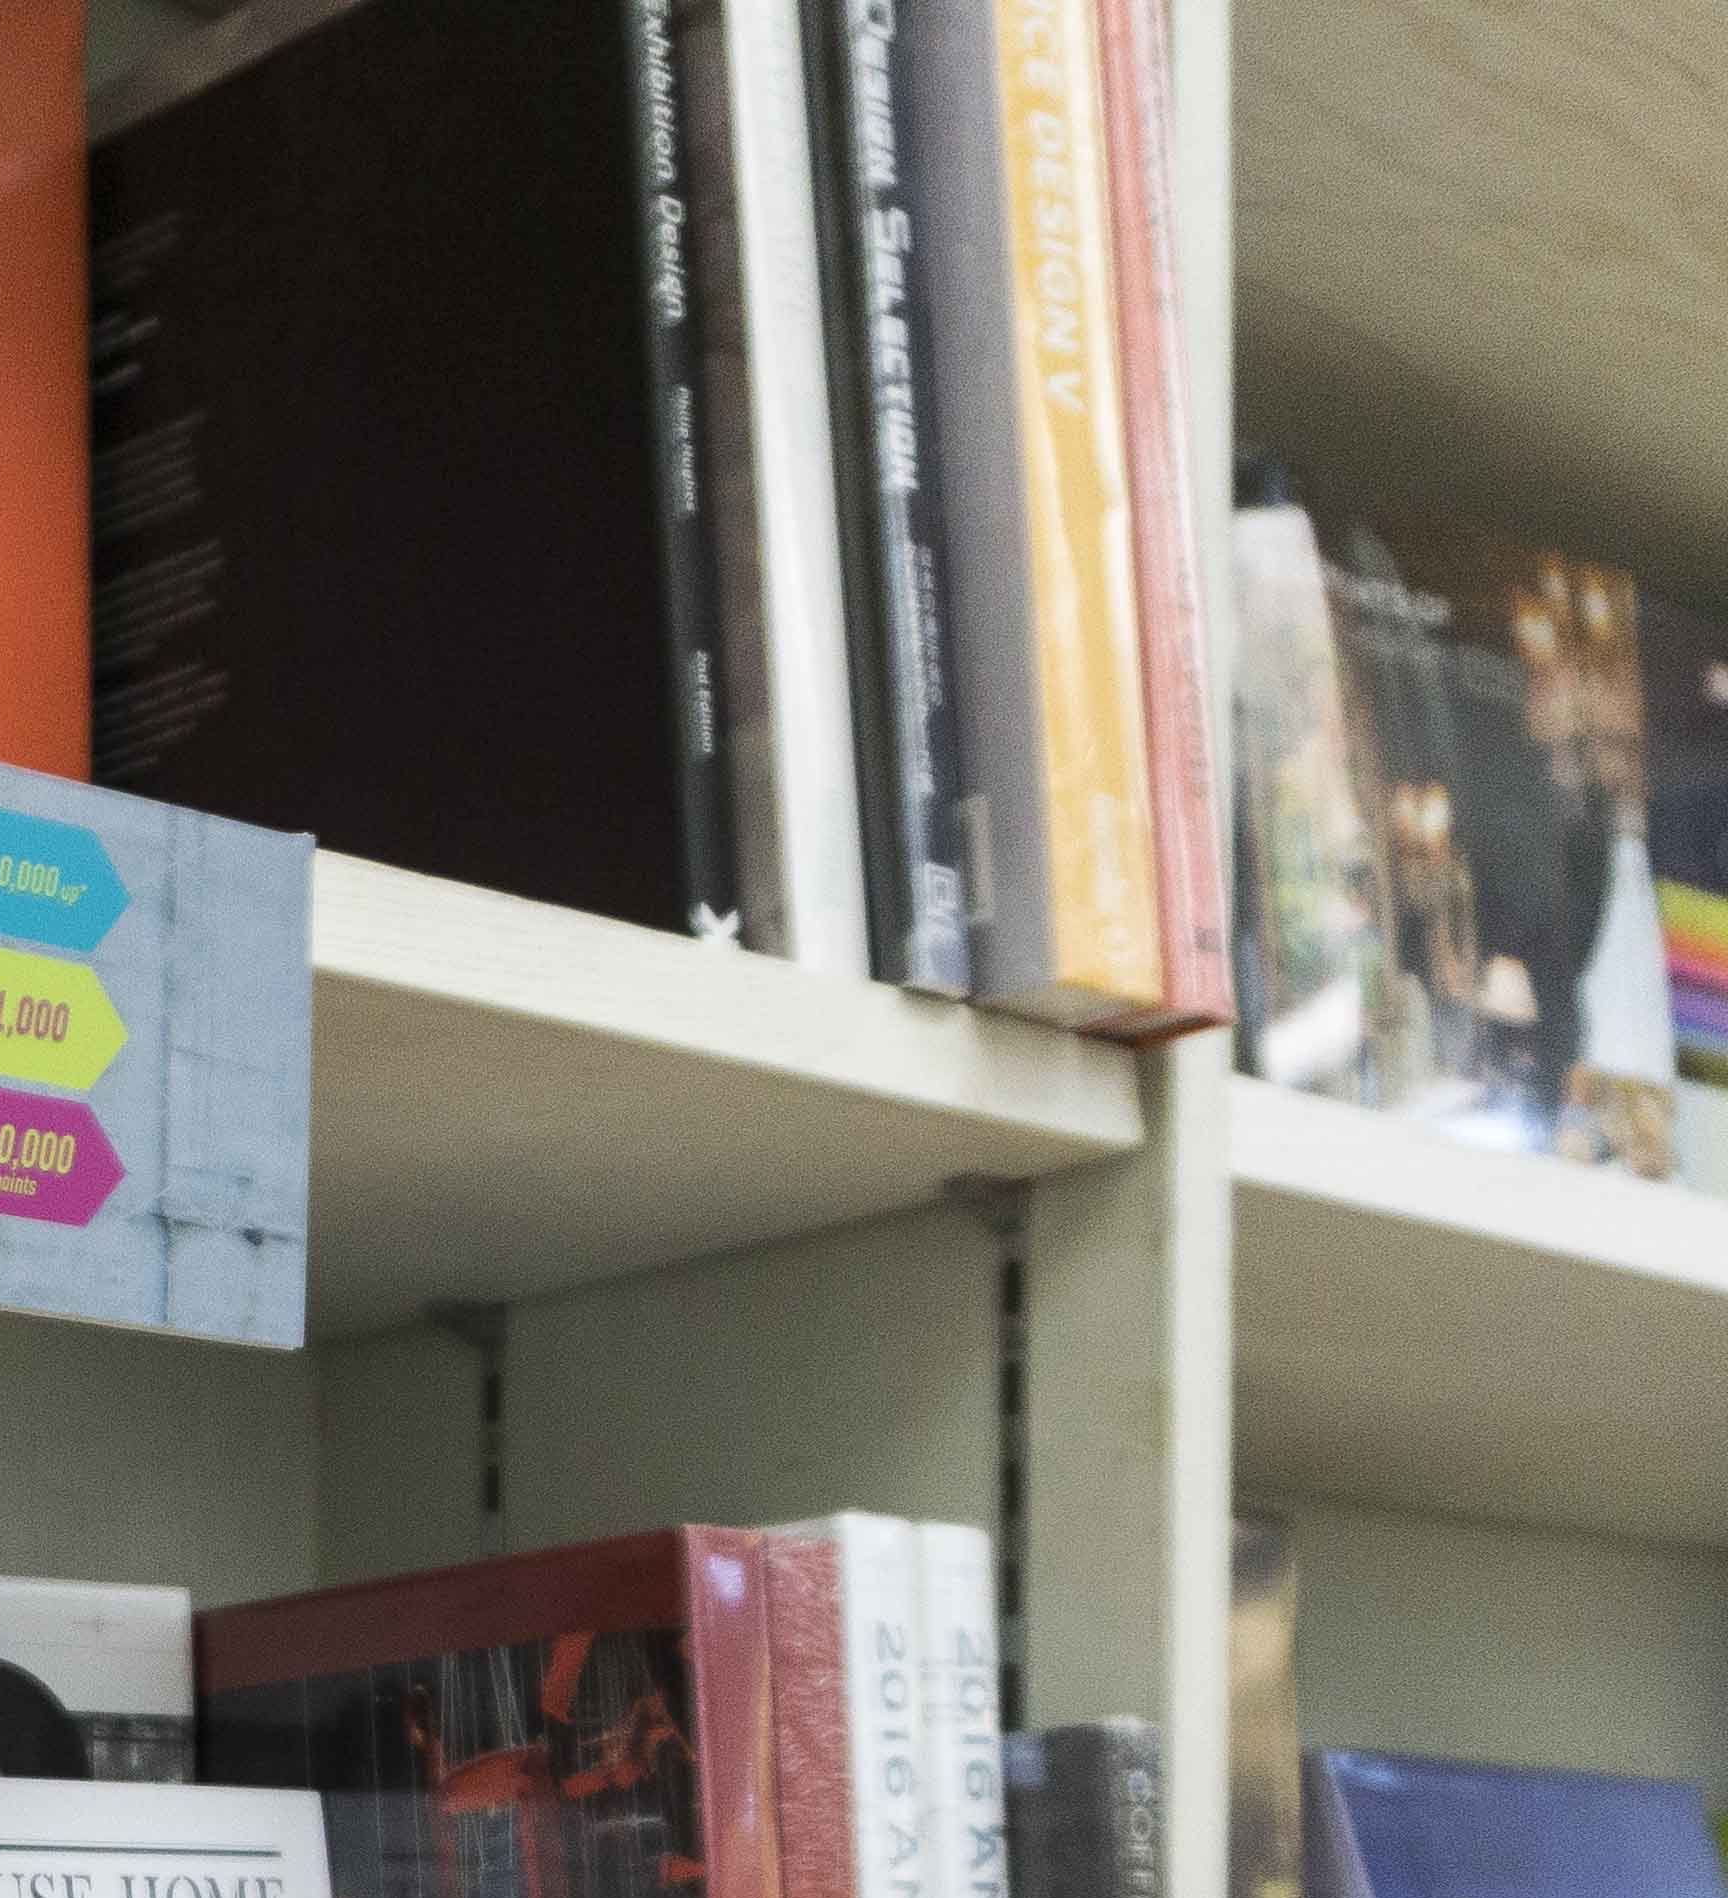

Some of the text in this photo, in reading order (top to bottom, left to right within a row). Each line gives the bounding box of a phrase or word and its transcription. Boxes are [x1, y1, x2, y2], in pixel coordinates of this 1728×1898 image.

[649, 193, 688, 320] Design
[875, 1622, 914, 1798] 2016
[956, 1629, 997, 1799] 2016
